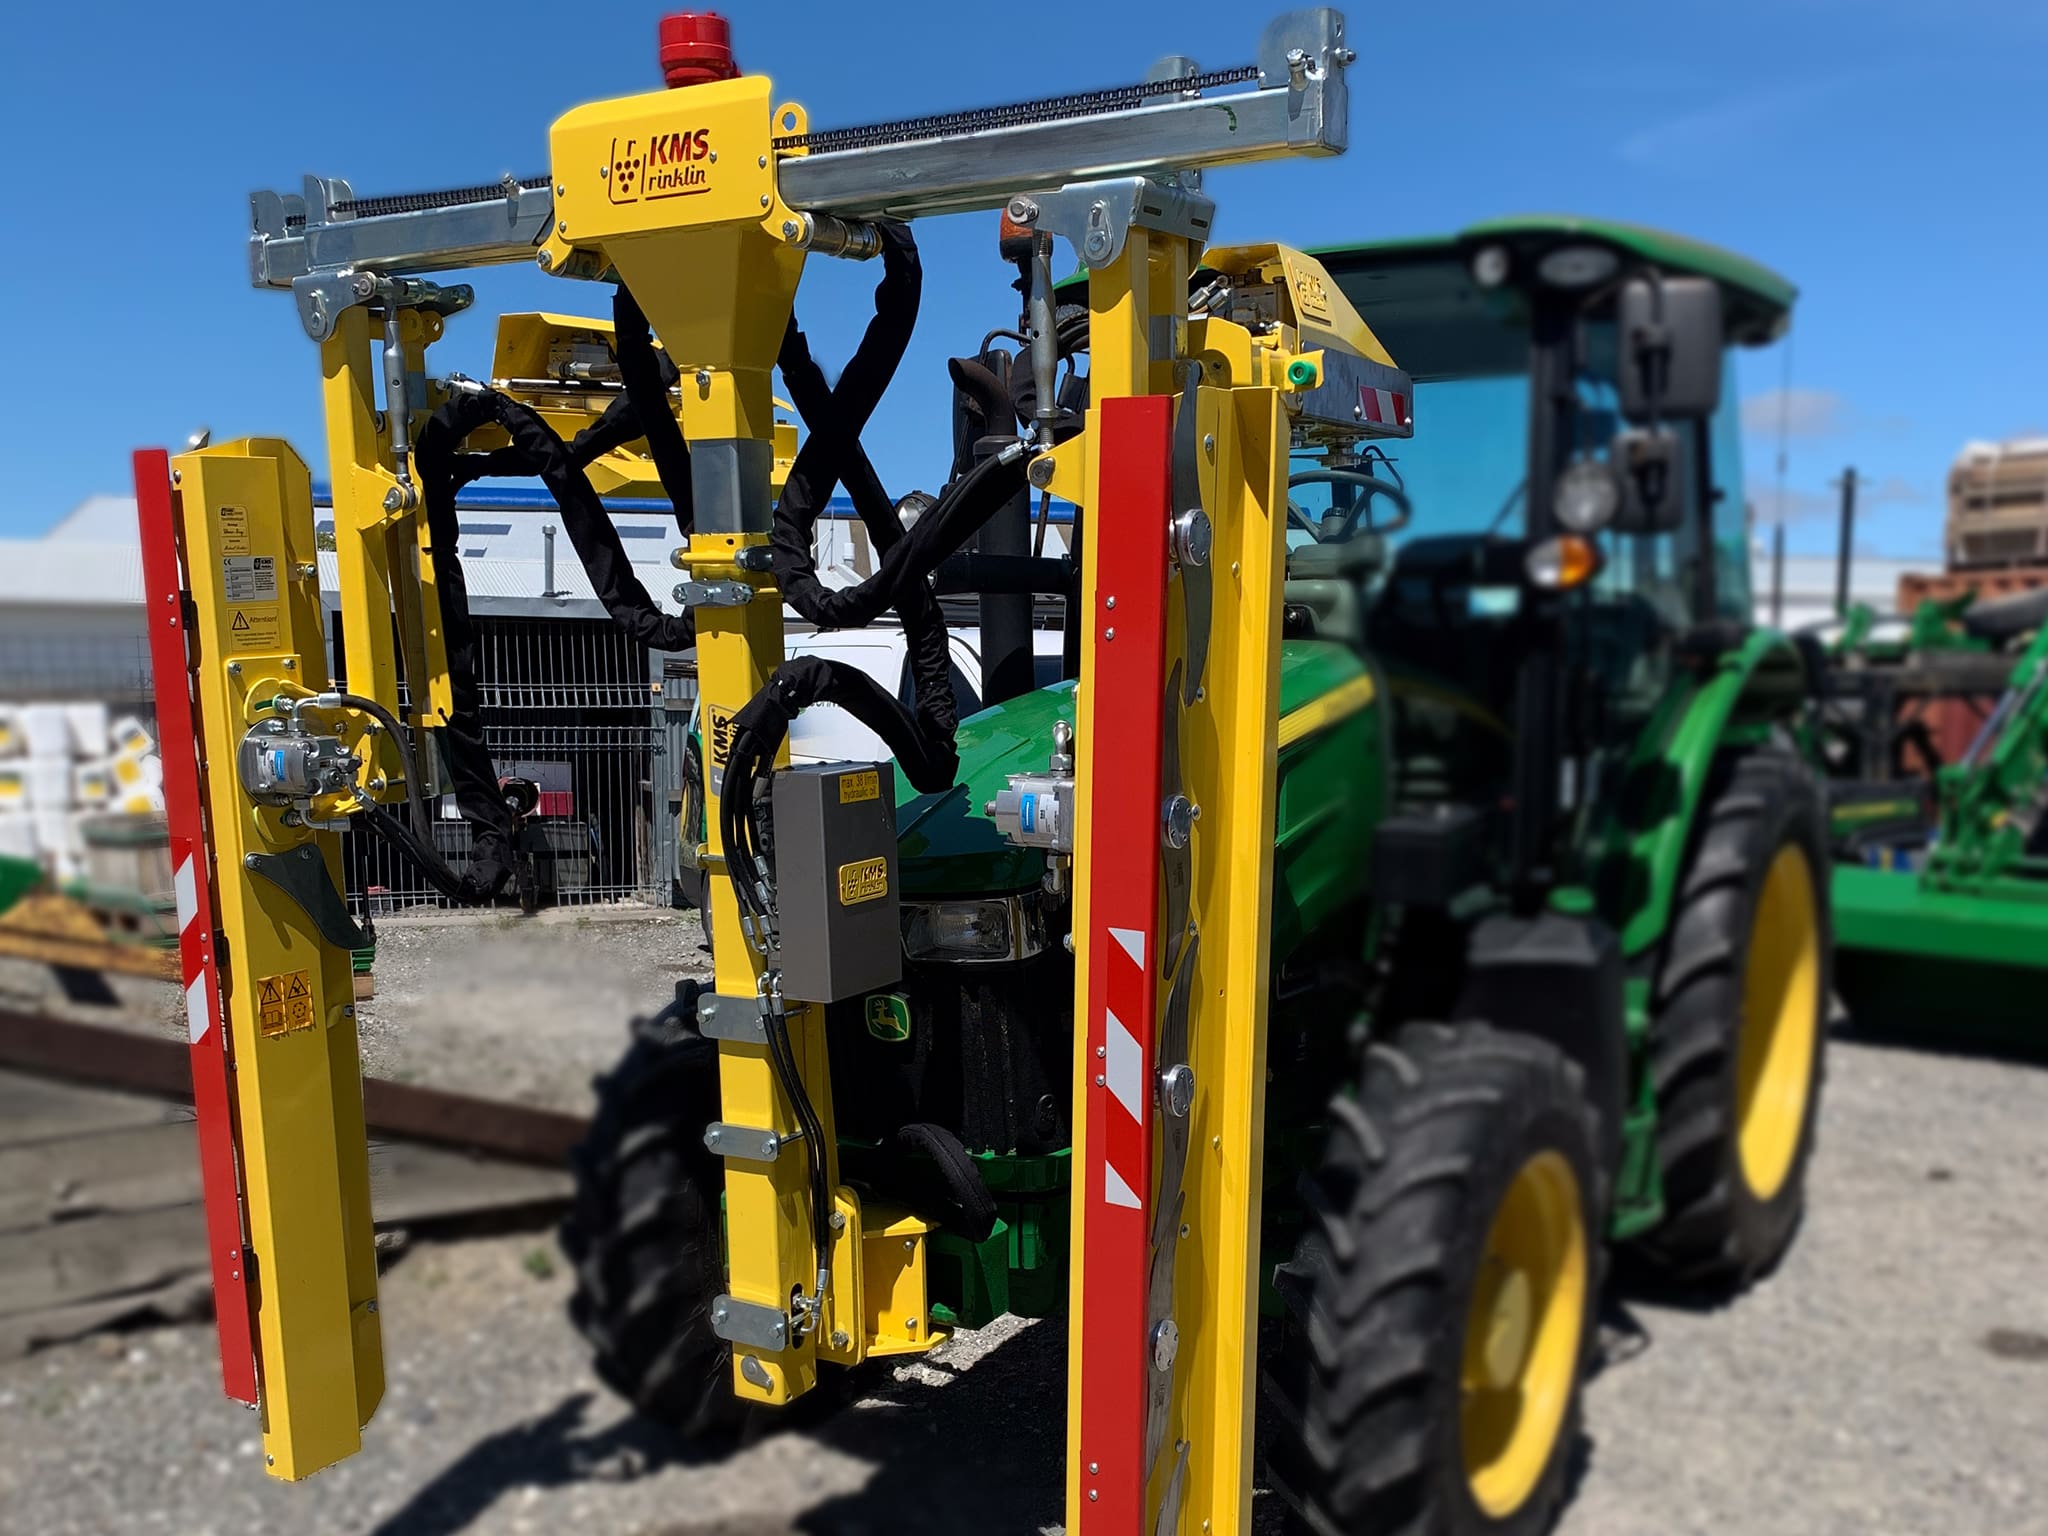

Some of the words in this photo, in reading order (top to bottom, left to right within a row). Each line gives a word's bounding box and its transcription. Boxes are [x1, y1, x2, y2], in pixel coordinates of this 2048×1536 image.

[649, 128, 710, 167] KMS
[648, 164, 706, 191] rinklin
[712, 713, 730, 766] KMS
[860, 863, 884, 882] KMS
